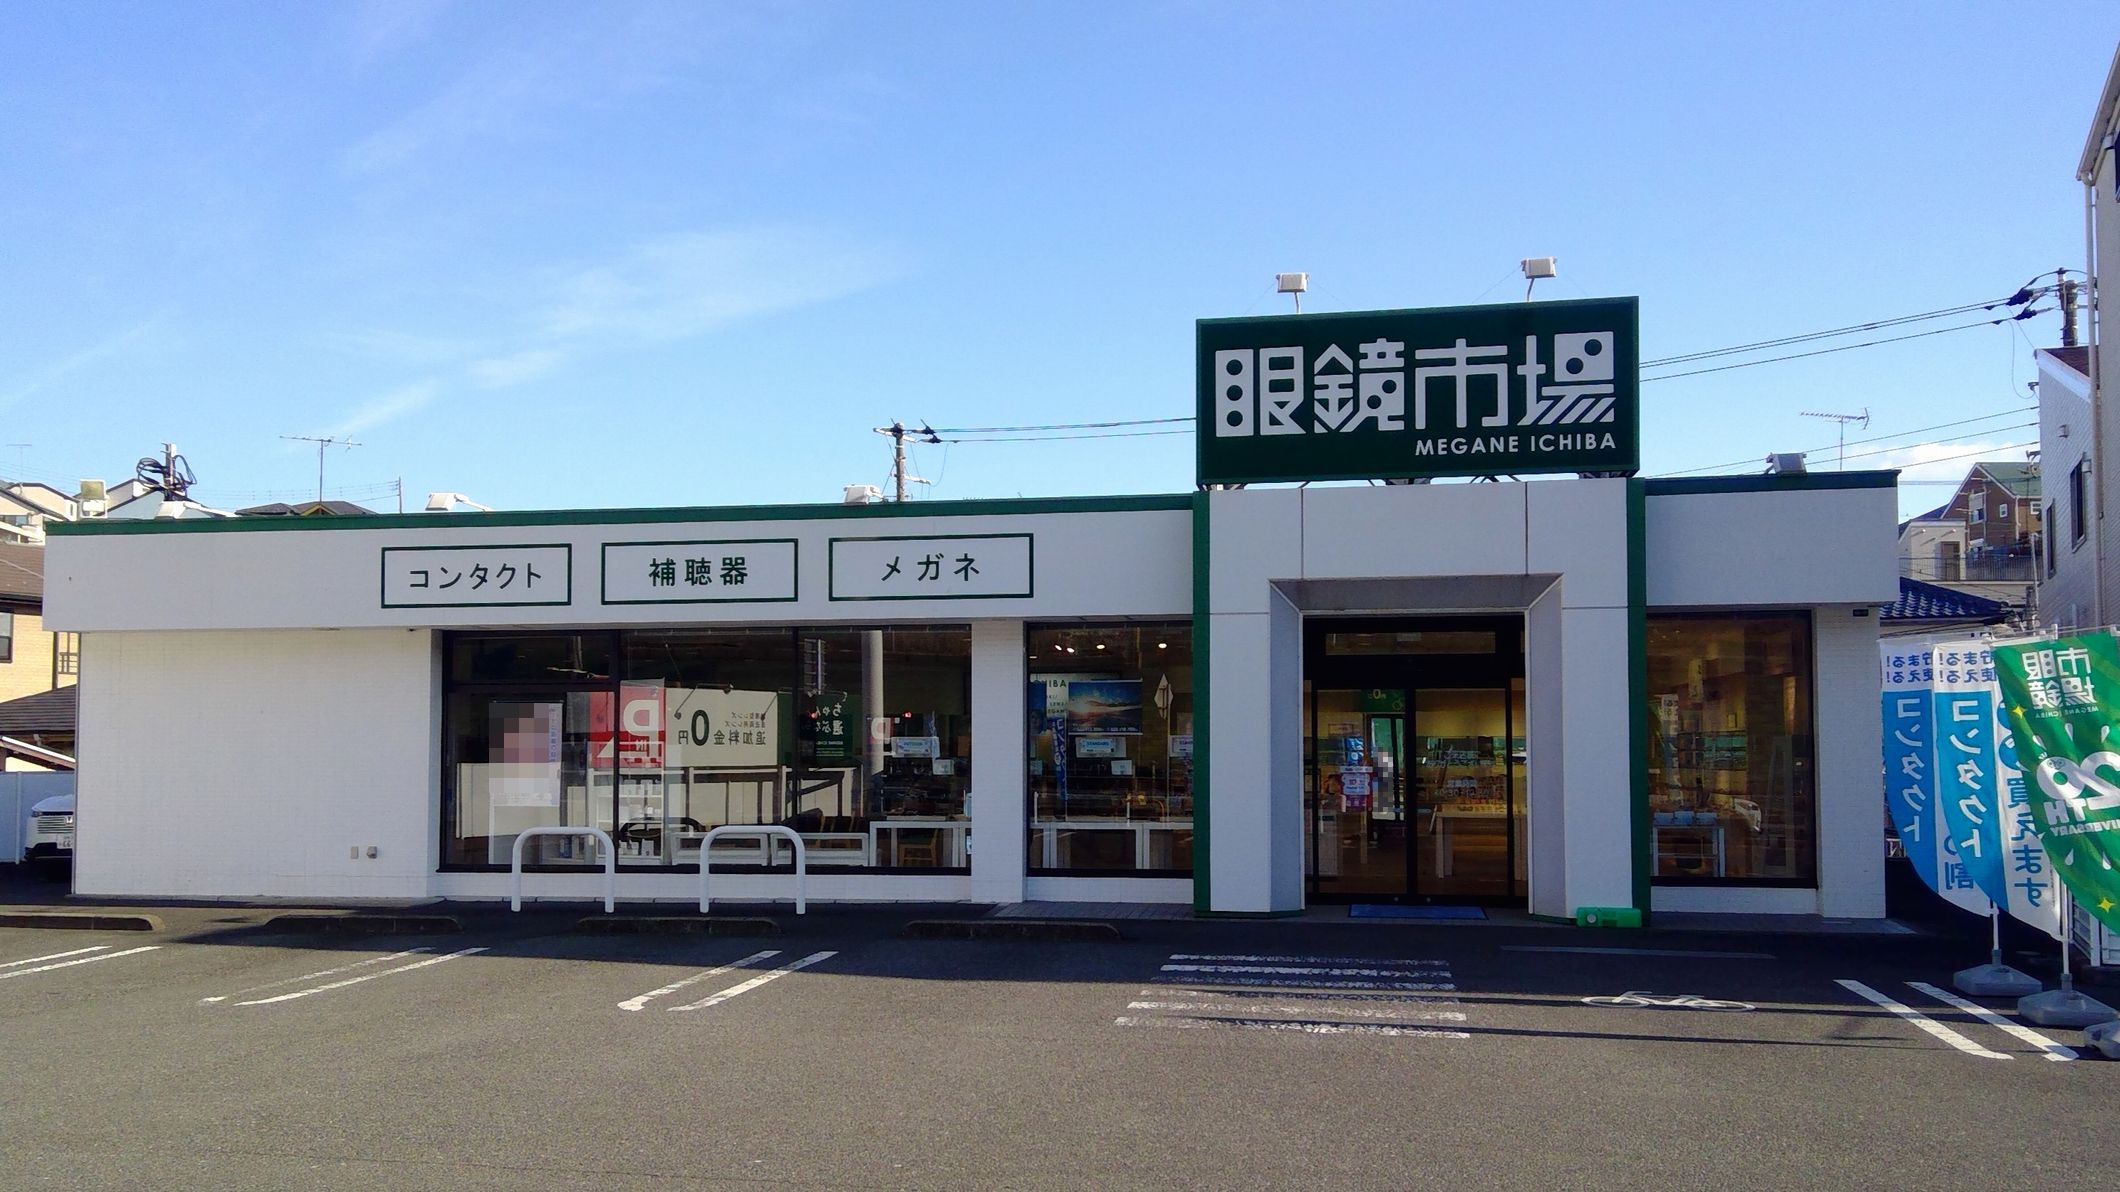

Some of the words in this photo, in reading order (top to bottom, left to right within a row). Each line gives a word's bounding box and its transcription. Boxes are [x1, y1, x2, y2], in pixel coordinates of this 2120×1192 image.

[1215, 331, 1617, 437] 眼鏡市場
[1415, 435, 1519, 456] MEGANE
[1531, 432, 1617, 452] ICHIBA
[409, 562, 543, 590] コンタクト
[648, 556, 749, 587] 補聴器
[881, 552, 981, 583] メガネ
